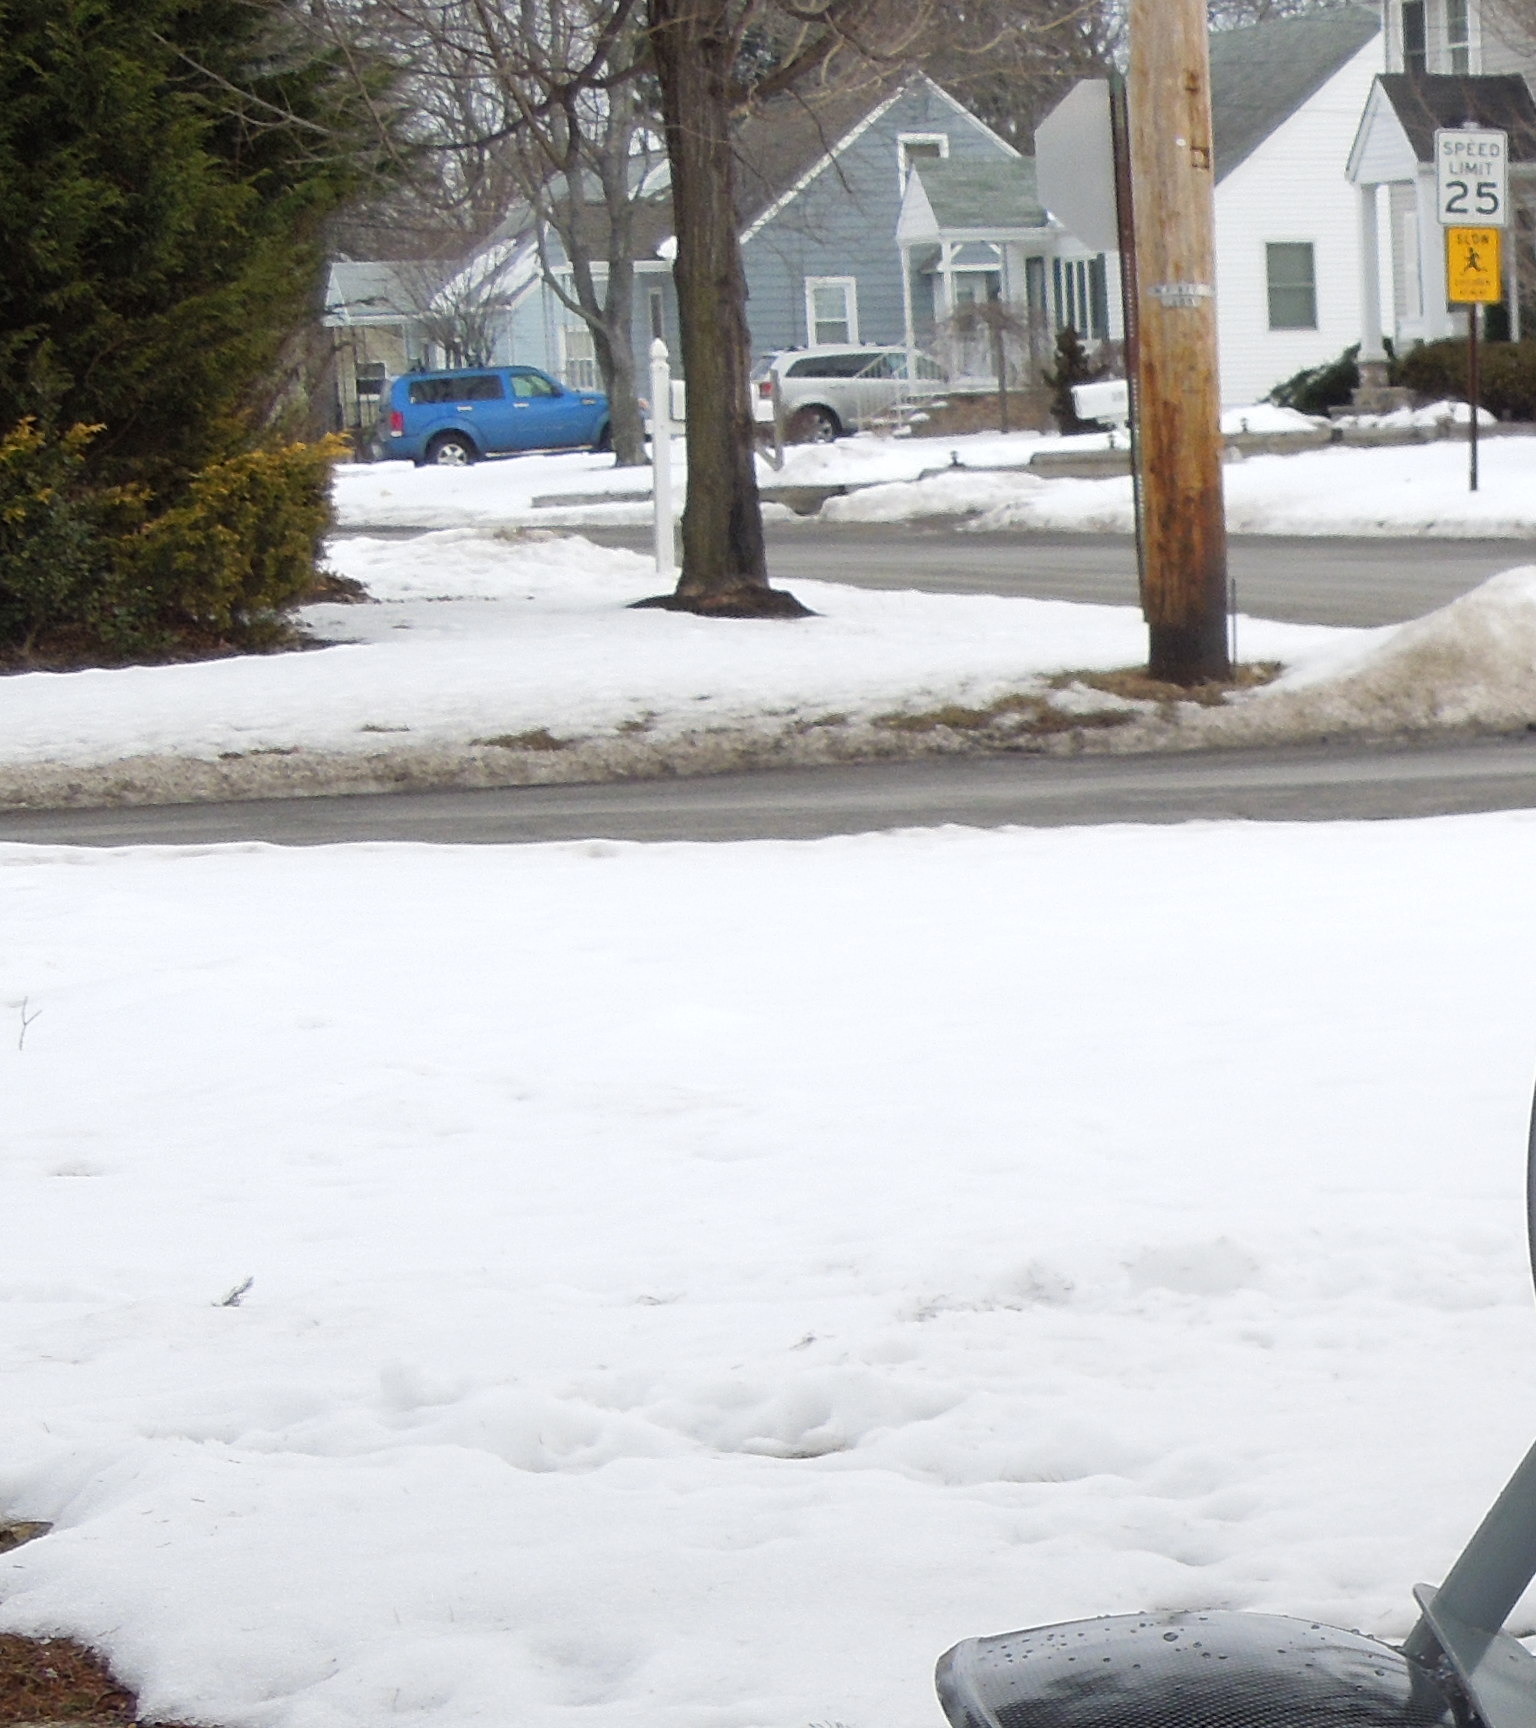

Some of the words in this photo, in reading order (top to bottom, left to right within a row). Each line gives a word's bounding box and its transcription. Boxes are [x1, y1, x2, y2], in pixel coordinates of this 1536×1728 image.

[1443, 142, 1500, 156] SPEED
[1449, 161, 1492, 175] LIMIT
[1446, 181, 1499, 214] 25
[1457, 233, 1490, 245] SLOW
